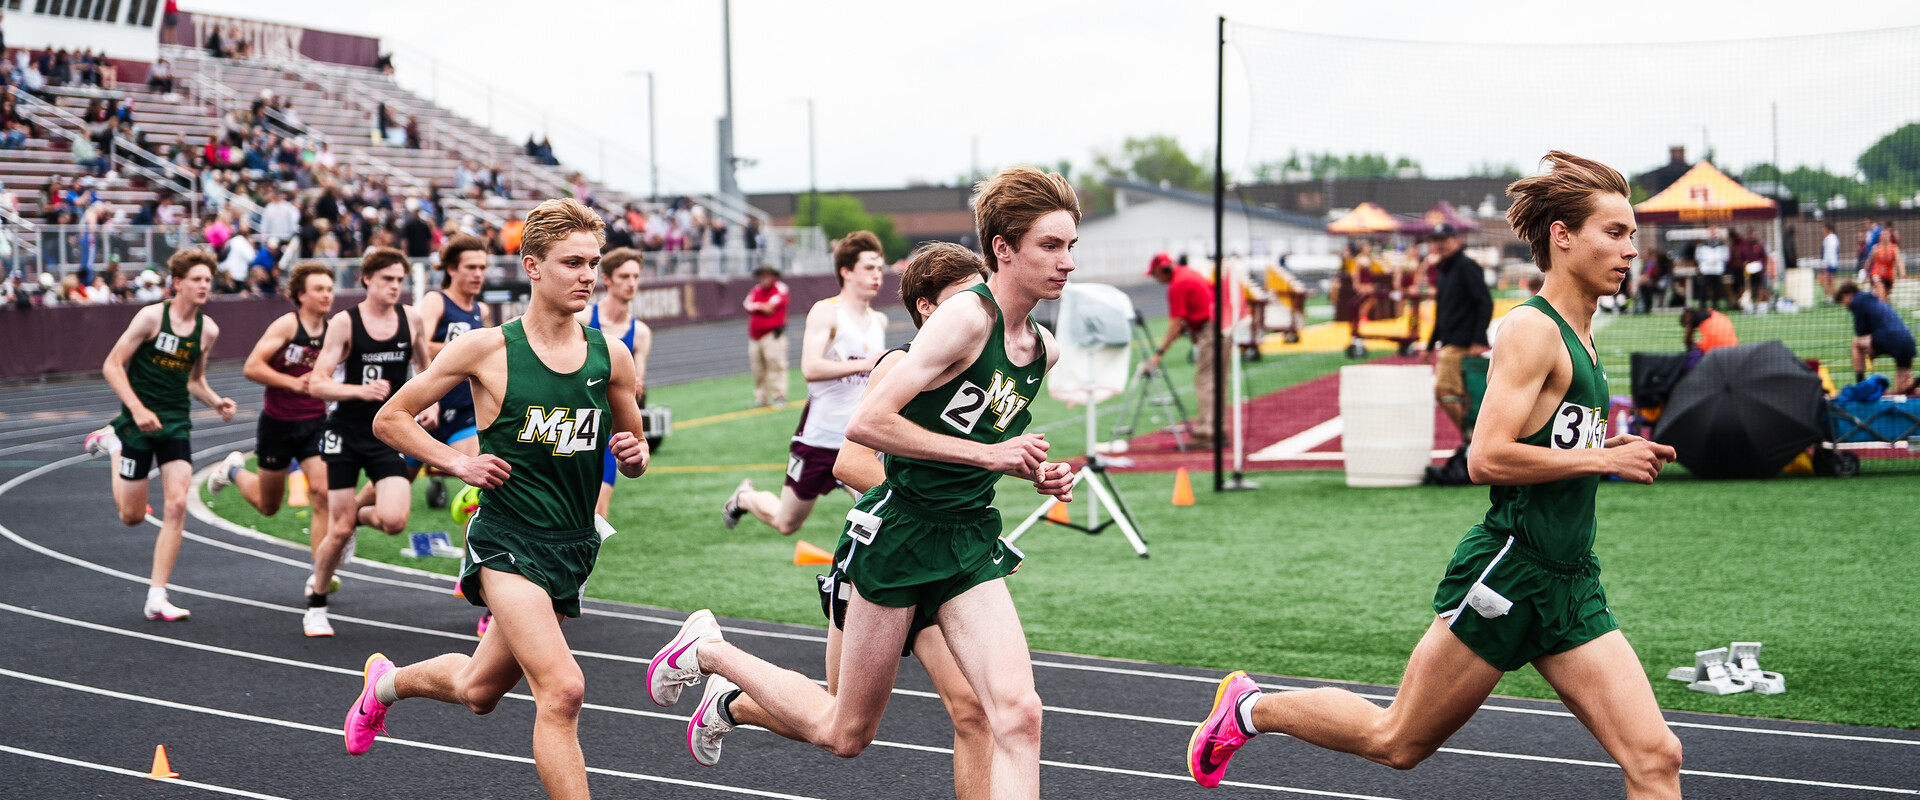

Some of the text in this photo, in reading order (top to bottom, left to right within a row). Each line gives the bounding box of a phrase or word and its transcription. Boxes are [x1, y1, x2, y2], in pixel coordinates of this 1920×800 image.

[160, 335, 177, 351] 11
[361, 351, 405, 363] ROSEVILLE
[944, 386, 986, 429] 2
[576, 409, 596, 447] 4
[1554, 405, 1584, 450] 3
[790, 454, 801, 474] 7
